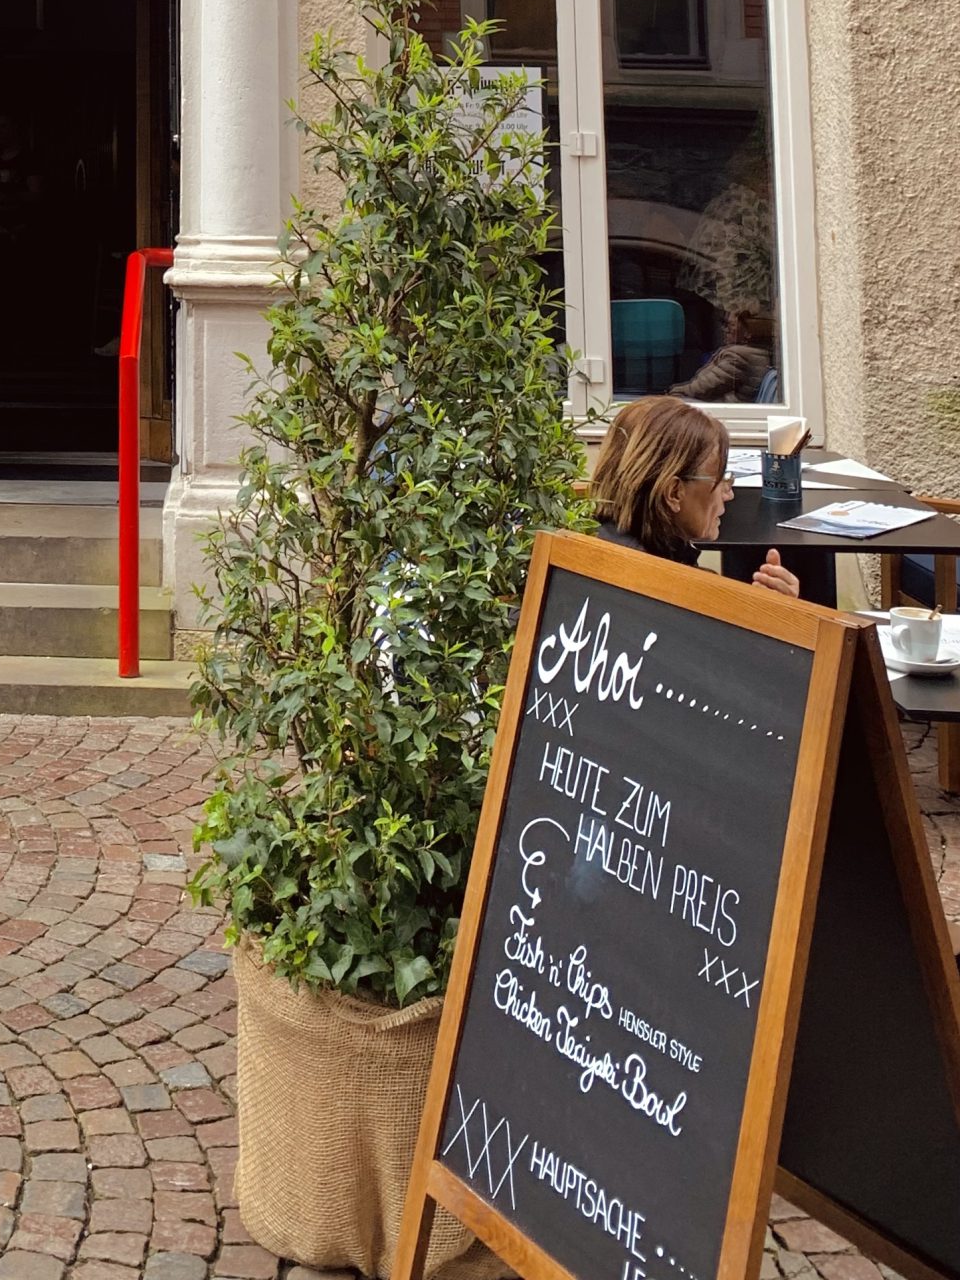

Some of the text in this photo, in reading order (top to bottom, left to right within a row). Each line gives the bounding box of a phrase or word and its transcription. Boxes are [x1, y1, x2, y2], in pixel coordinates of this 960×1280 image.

[538, 596, 657, 710] Ahoi
[539, 742, 671, 847] HEUTE ZUM
[574, 813, 740, 946] HALBEN PREIS
[504, 904, 545, 974] Fish
[567, 945, 613, 1019] Chips
[618, 1006, 667, 1054] HENSSLER
[669, 1039, 703, 1073] STYLE
[494, 968, 552, 1042] Chicken
[622, 1053, 687, 1137] Bowl
[530, 1141, 647, 1262] HAUPTSACHE
